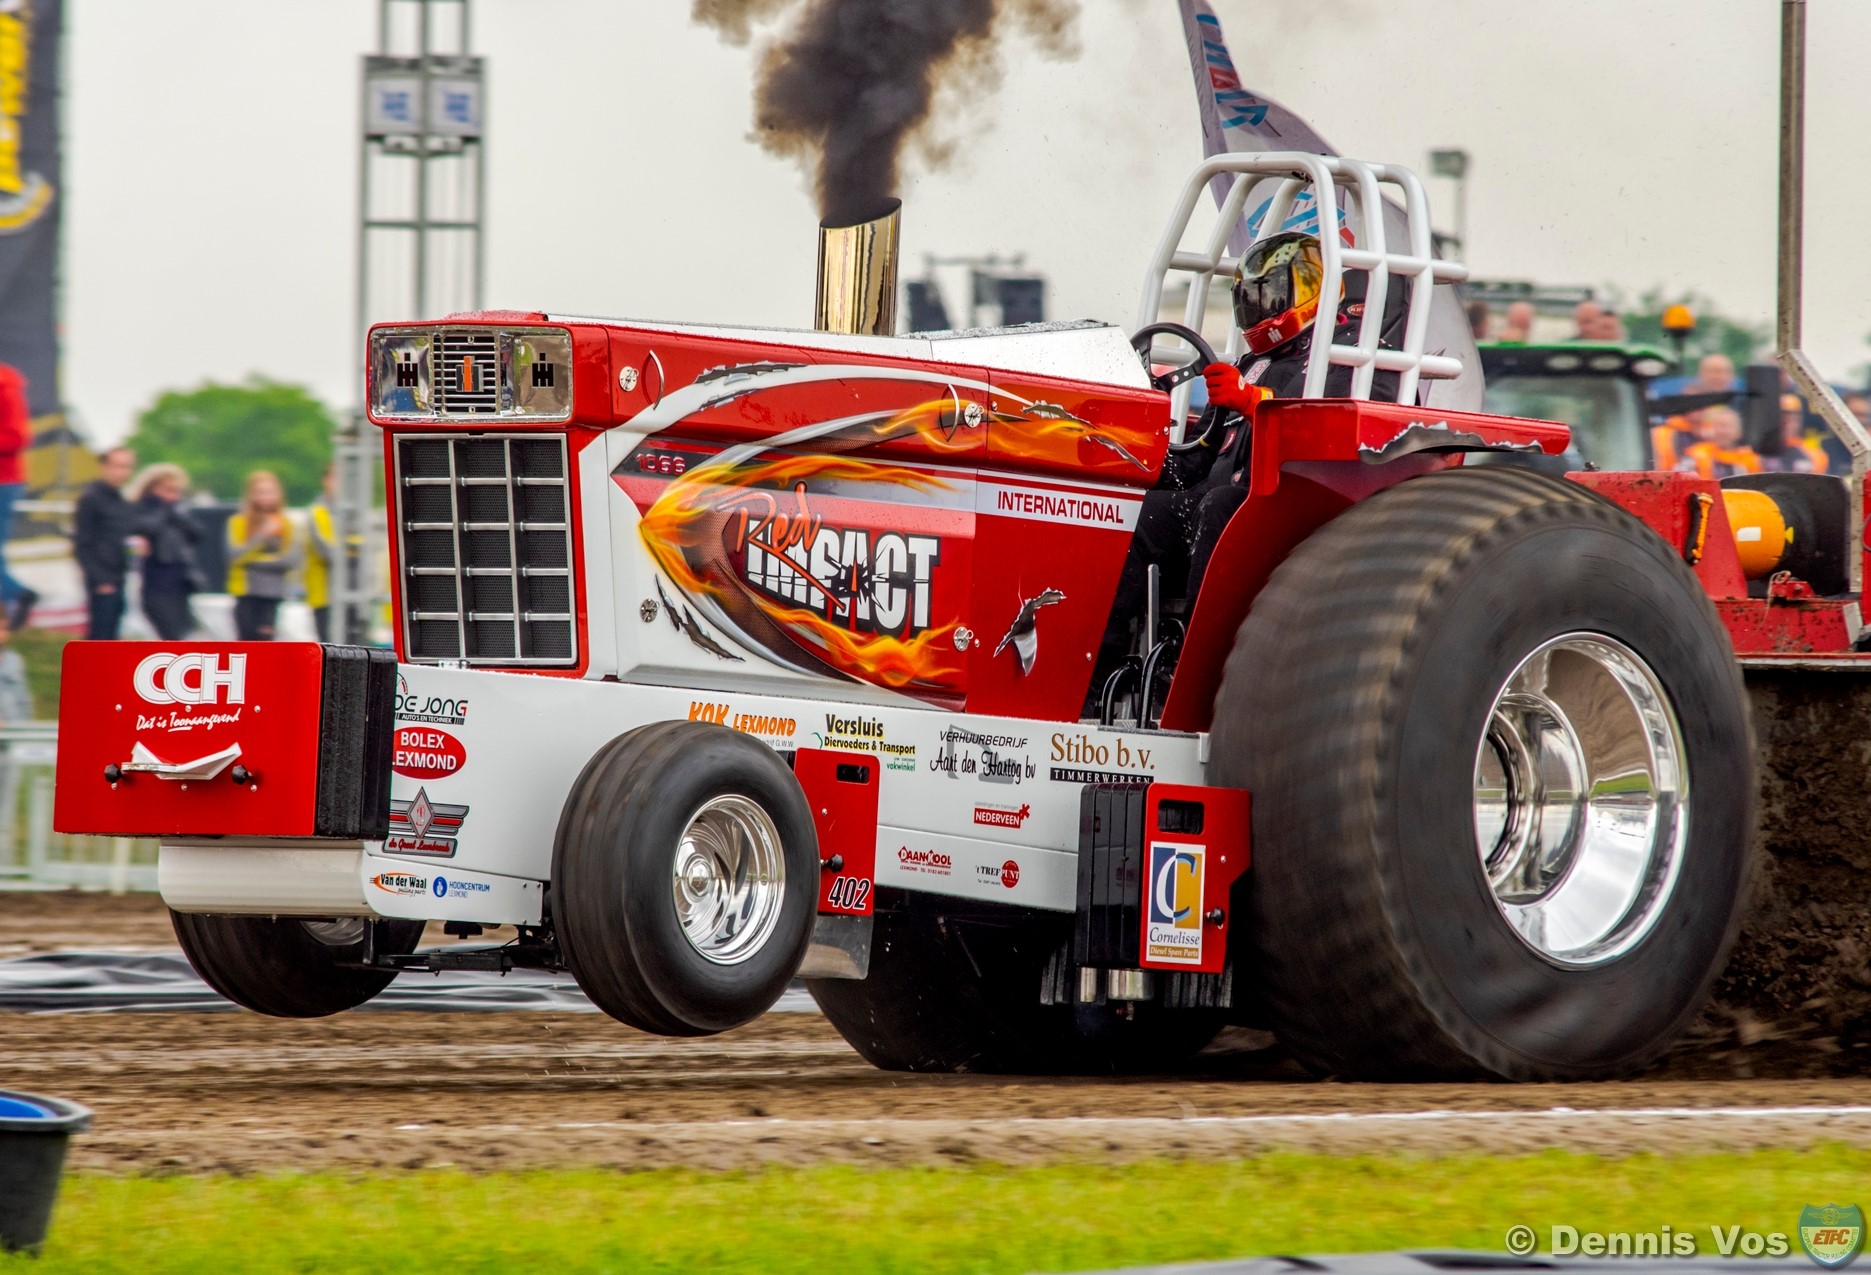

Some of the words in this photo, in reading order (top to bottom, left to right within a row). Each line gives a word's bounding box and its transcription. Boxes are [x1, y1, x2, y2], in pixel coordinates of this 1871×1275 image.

[635, 453, 686, 475] 1066
[997, 490, 1124, 524] INTERNATIONAL
[746, 519, 940, 631] IMPACT
[133, 652, 247, 705] CCH
[419, 697, 469, 717] JONG
[136, 714, 156, 731] Dat
[156, 716, 167, 728] is
[168, 707, 242, 732] Toonaangevend
[401, 713, 420, 721] AUTO'S
[428, 716, 453, 724] TECHNIEK
[688, 701, 730, 726] KOK
[732, 713, 797, 737] LEXMOND
[826, 713, 884, 737] Versluis
[401, 731, 445, 749] BOLEX
[824, 735, 870, 751] Diervoeders
[871, 740, 877, 751] &
[879, 741, 916, 756] Transport
[940, 730, 1028, 748] VERHUURBEDRIJF
[1051, 733, 1109, 765] Stibo
[1116, 738, 1155, 770] b.v.
[886, 761, 916, 772] vakwinkel
[930, 746, 958, 772] Aart
[961, 750, 977, 774] den
[981, 750, 1022, 785] Hartog
[1025, 755, 1036, 779] bv
[975, 811, 1020, 826] NEDERVEEN
[380, 873, 394, 886] Van
[395, 875, 408, 887] der
[409, 877, 427, 889] Waal
[1156, 852, 1197, 922] C
[828, 876, 871, 910] 402
[1149, 926, 1200, 945] Cornelisse
[1150, 945, 1167, 956] Diesel
[1167, 946, 1183, 958] Spare
[1183, 948, 1199, 959] Parts
